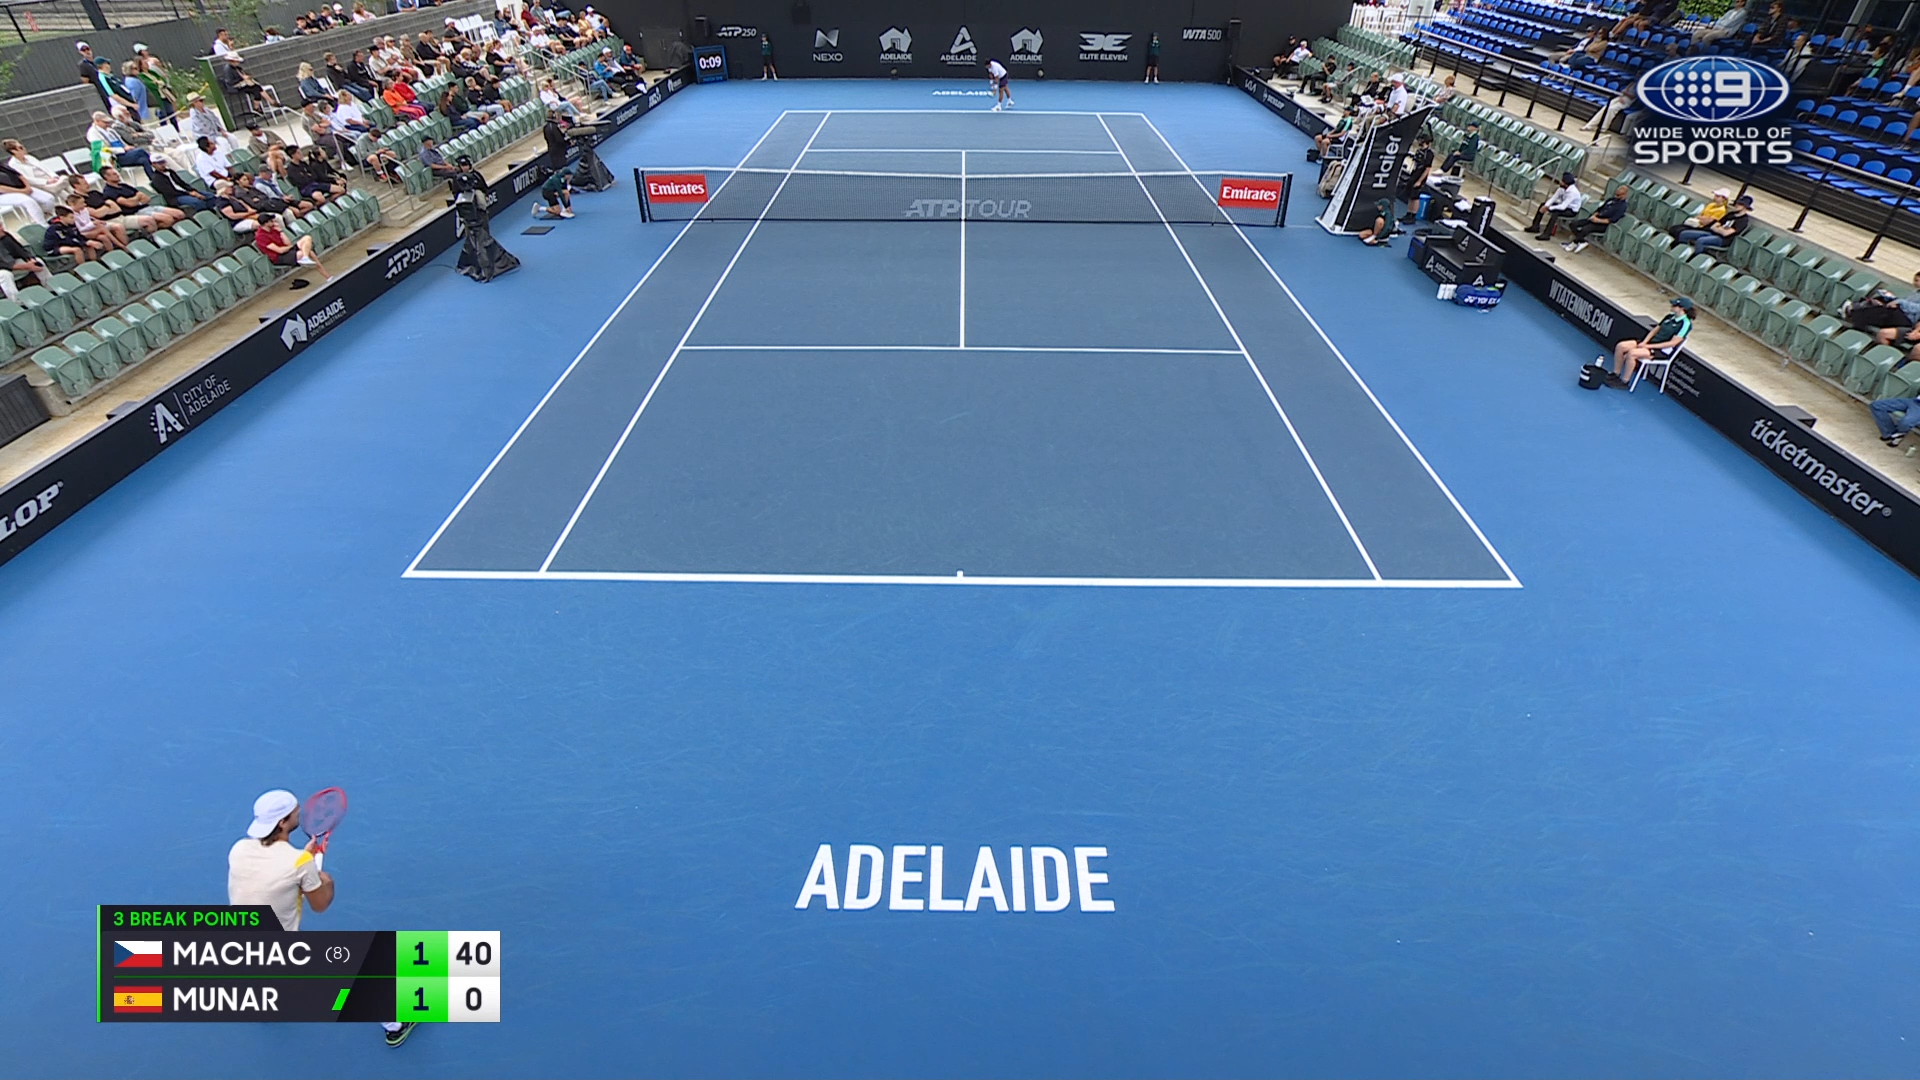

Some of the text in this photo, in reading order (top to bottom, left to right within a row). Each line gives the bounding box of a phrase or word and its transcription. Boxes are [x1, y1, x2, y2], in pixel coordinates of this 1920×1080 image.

[699, 55, 722, 70] 0:09
[812, 53, 844, 62] NEXO
[880, 53, 913, 61] ADELAIDE
[1079, 53, 1099, 61] ELITE
[1372, 134, 1402, 189] Haier
[649, 182, 705, 196] Emirates
[1221, 186, 1277, 201] Emirates
[902, 199, 1032, 218] ATP TOUR
[307, 298, 346, 331] ADELAIDE
[1549, 279, 1614, 338] WTATENNIS.COM
[182, 374, 217, 404] CITY OF
[188, 379, 232, 416] ADELAIDE
[794, 843, 1116, 912] ADELAIDE
